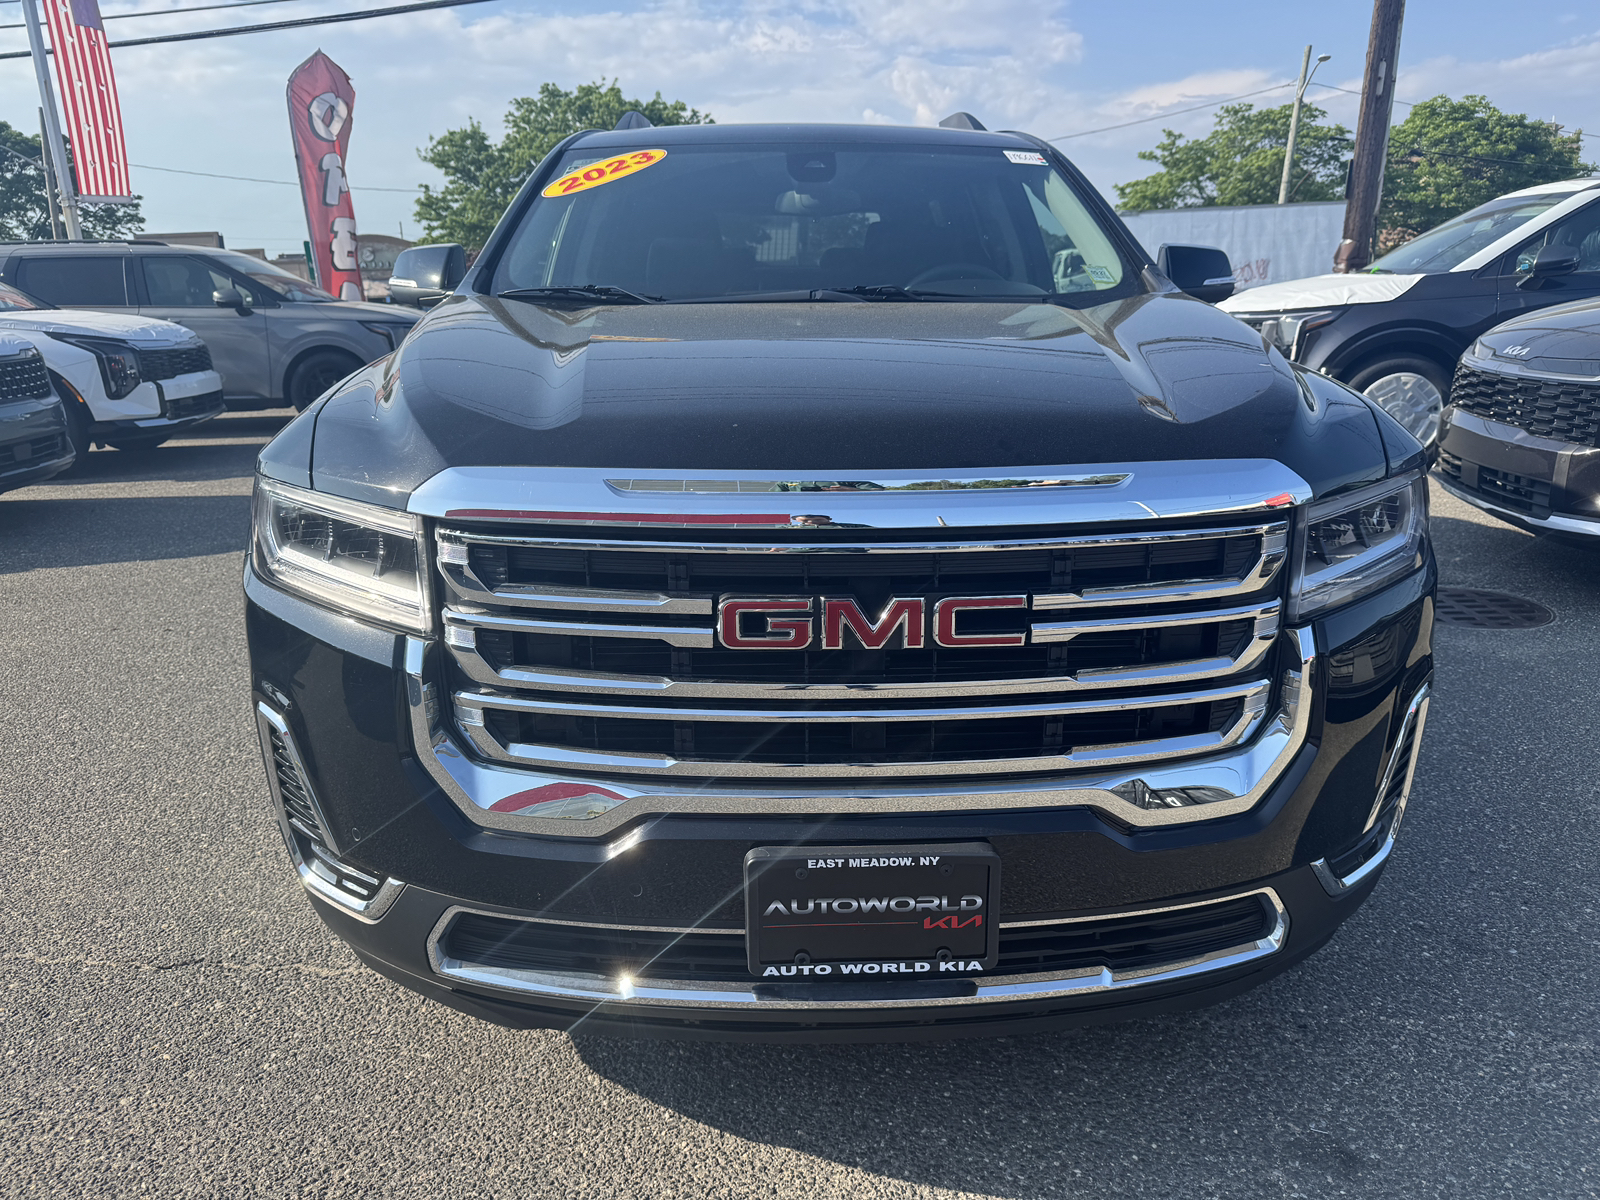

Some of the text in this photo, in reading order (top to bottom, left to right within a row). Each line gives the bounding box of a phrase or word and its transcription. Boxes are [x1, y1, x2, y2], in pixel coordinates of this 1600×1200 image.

[558, 151, 656, 193] 2023
[717, 594, 1027, 650] GMC
[807, 859, 844, 869] EAST
[920, 856, 940, 866] NY
[763, 895, 983, 916] AUTOWORLD
[924, 915, 983, 929] KIA
[762, 960, 984, 977] AUTO WORLD KIA
